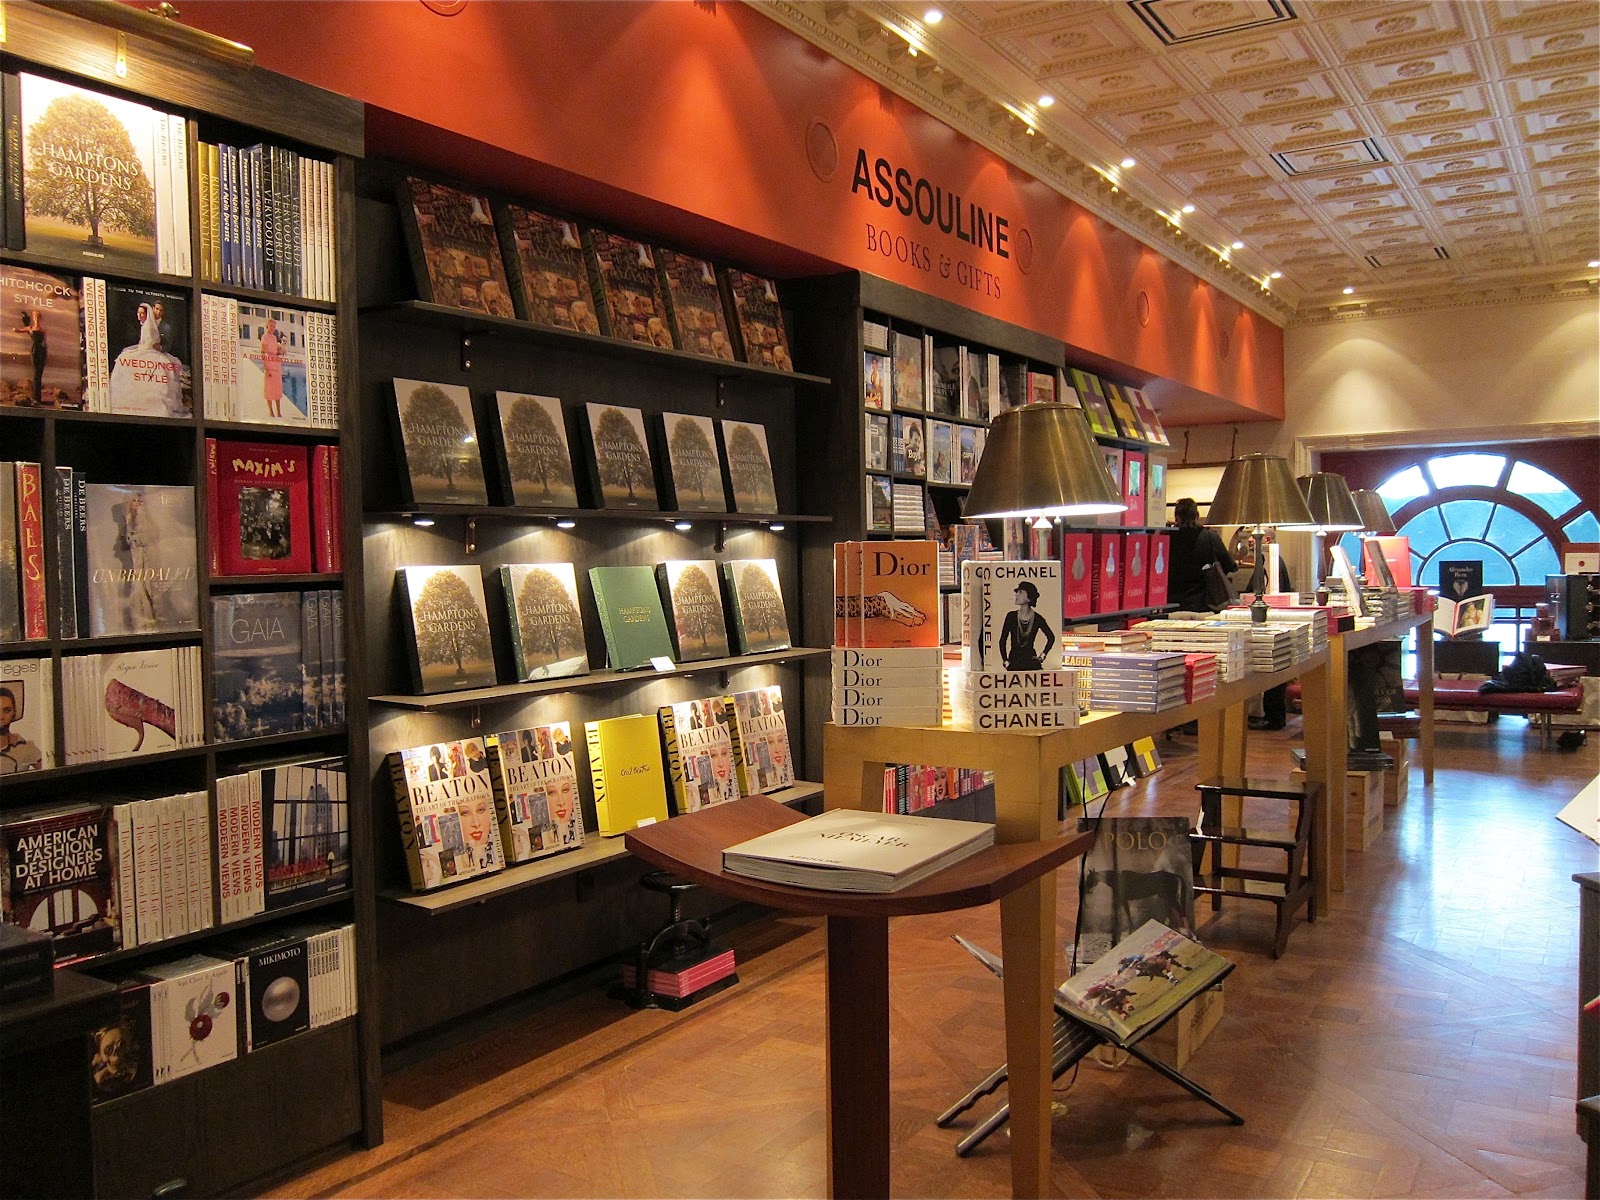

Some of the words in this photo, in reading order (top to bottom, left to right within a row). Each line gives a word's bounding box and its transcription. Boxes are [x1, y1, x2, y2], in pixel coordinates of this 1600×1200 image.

[42, 142, 139, 176] HAMPTONS
[50, 161, 131, 191] GARDENS
[852, 148, 1009, 259] ASSOULINE
[264, 189, 274, 263] VERVOORDT
[866, 223, 931, 272] BOOKS
[939, 253, 951, 279] &
[957, 261, 1001, 299] GIFTS
[0, 276, 71, 297] HITCHCOCK
[14, 294, 54, 308] STYLE
[86, 282, 95, 337] WEDDINGS
[97, 284, 106, 339] WEDDINGS
[88, 341, 95, 354] OF
[99, 343, 106, 357] OF
[308, 315, 316, 369] PIONEERS
[316, 316, 324, 370] PIONEERS
[89, 357, 97, 388] STYLE
[134, 372, 168, 384] STYLE
[310, 373, 318, 424] POSSIBLE
[318, 374, 326, 424] POSSIBLE
[411, 422, 468, 437] HAMPTONS
[512, 432, 560, 445] HAMPTONS
[417, 435, 465, 449] GARDENS
[517, 444, 558, 456] GARDENS
[601, 441, 643, 453] HAMPTONS
[606, 451, 641, 462] GARDENS
[675, 448, 713, 459] HAMPTONS
[679, 456, 712, 467] GARDENS
[232, 457, 296, 478] MAXIM'S
[78, 480, 86, 496] DE
[873, 551, 931, 576] Dior
[995, 566, 1057, 578] CHANEL
[93, 567, 195, 584] UNBRIDALED
[678, 594, 716, 604] HAMPTONS
[744, 591, 777, 601] HAMPTONS
[748, 601, 776, 609] GARDENS
[306, 597, 318, 630] GAIA
[319, 596, 332, 627] GAIA
[333, 596, 344, 627] GAIA
[423, 608, 479, 621] HAMPTONS
[525, 602, 573, 615] HAMPTONS
[683, 604, 714, 613] GARDENS
[983, 567, 992, 655] CHANEL
[429, 620, 476, 633] GARDENS
[531, 613, 571, 626] GARDENS
[230, 617, 285, 644] GAIA
[843, 650, 883, 667] Dior
[843, 669, 883, 687] Dior
[979, 673, 1063, 689] CHANEL
[842, 689, 883, 706] Dior
[979, 692, 1063, 708] CHANEL
[741, 714, 785, 735] BEATON
[842, 708, 882, 726] Dior
[979, 712, 1065, 729] CHANEL
[663, 714, 682, 782] BEATON
[680, 726, 730, 749] BEATON
[507, 756, 574, 785] BEATON
[588, 729, 605, 803] BEATON
[411, 773, 489, 806] BEATON
[219, 809, 229, 859] MODERN
[229, 806, 239, 857] MODERN
[240, 805, 250, 854] MODERN
[252, 801, 261, 850] MODERN
[17, 824, 98, 852] AMERICAN
[818, 832, 910, 848] NIEMEYER
[839, 831, 900, 842] OSCAR
[1103, 831, 1167, 850] POLO
[24, 838, 93, 863] FASHION
[789, 854, 842, 864] ASSOULINE
[15, 848, 103, 878] DESIGNERS
[254, 852, 262, 888] VIEWS
[24, 873, 43, 890] AT
[49, 862, 97, 884] HOME
[221, 862, 230, 899] VIEWS
[231, 860, 241, 896] VIEWS
[242, 857, 252, 893] VIEWS
[258, 947, 301, 967] MIKIMOTO
